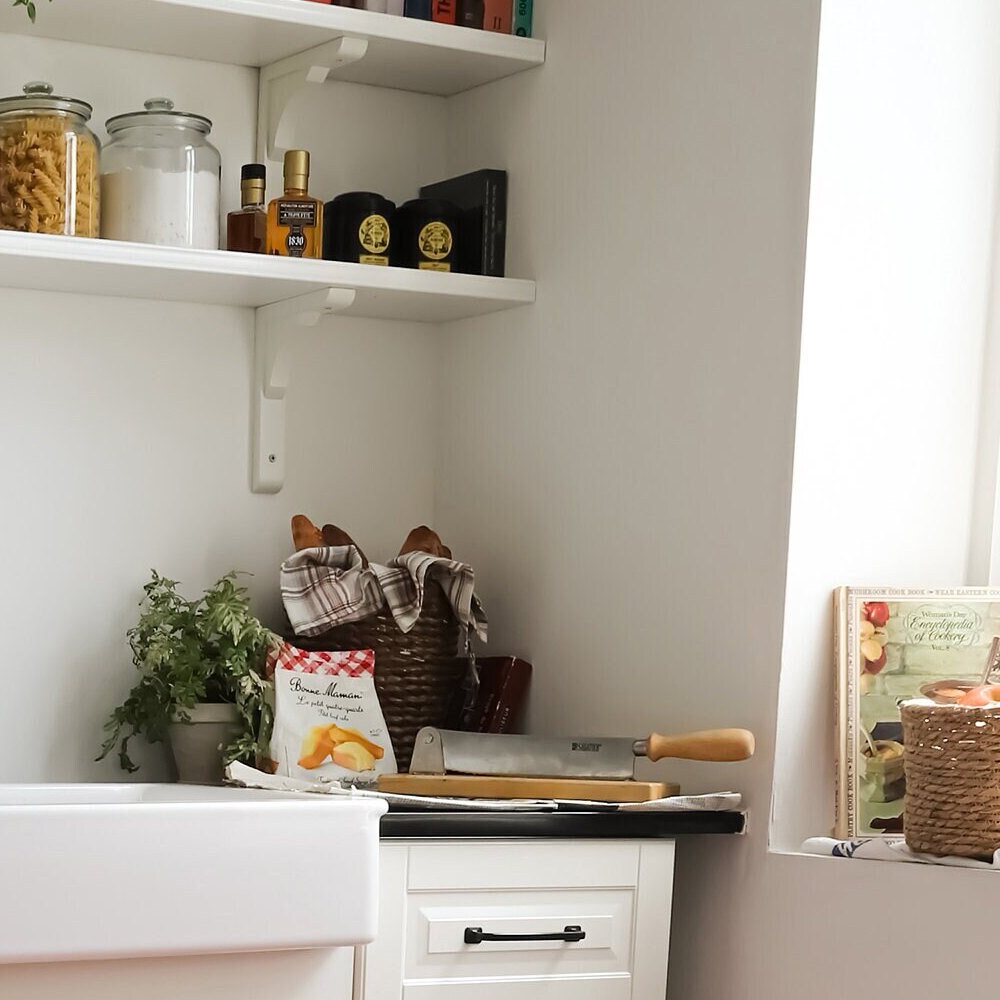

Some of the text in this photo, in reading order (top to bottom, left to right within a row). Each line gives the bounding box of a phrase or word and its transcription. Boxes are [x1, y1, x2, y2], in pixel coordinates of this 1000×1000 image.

[909, 616, 974, 632] Encyclopedia
[928, 630, 967, 645] Cookery
[289, 676, 363, 699] Bonne Maman
